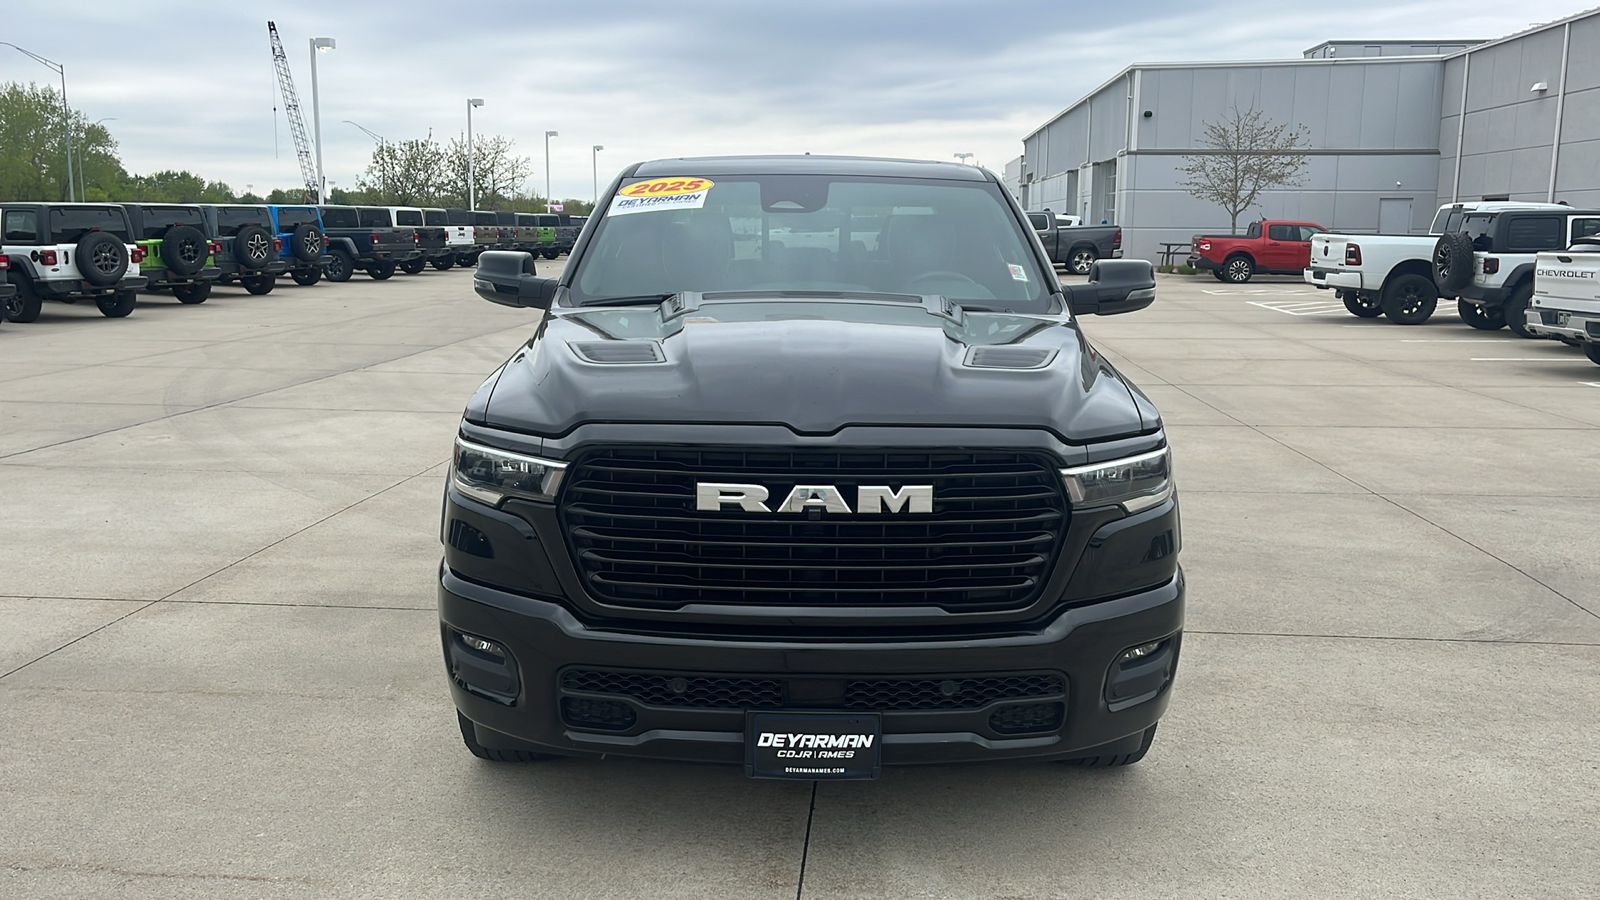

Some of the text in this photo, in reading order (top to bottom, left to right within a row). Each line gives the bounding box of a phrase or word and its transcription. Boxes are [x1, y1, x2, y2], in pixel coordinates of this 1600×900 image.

[628, 179, 705, 196] 2025
[617, 194, 702, 207] DEYARMAN
[1536, 269, 1597, 279] CHEVROLET
[696, 482, 934, 514] RAM
[757, 732, 875, 748] DEYARMAN
[818, 750, 855, 759] AMES
